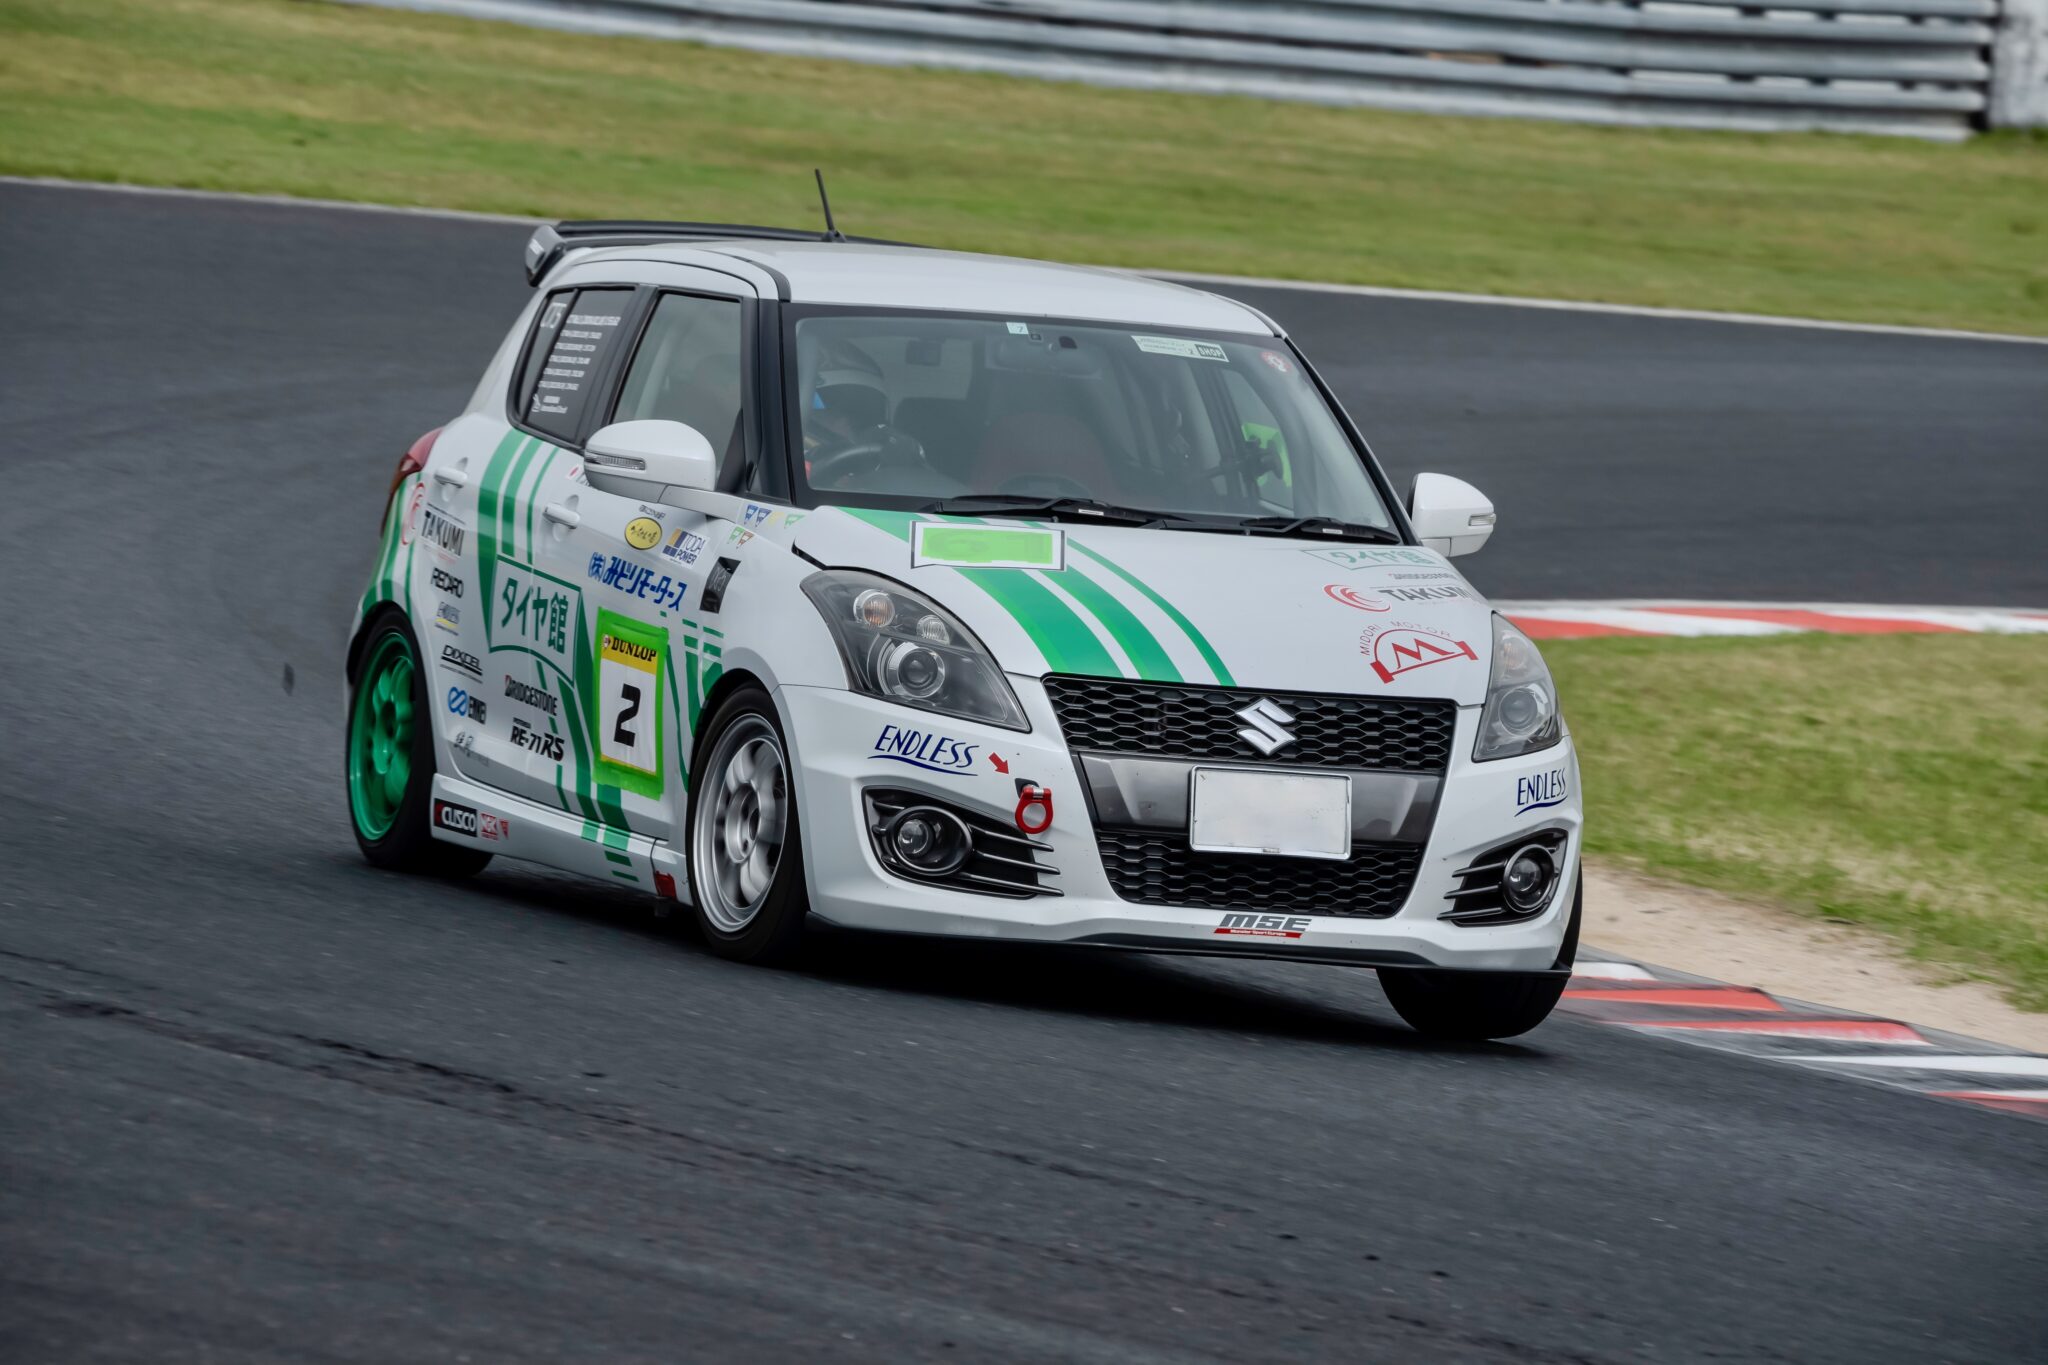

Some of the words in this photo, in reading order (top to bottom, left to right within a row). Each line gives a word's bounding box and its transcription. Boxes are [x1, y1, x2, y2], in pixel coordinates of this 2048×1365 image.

[675, 548, 698, 566] POWER
[501, 577, 569, 655] タイヤ館
[611, 636, 657, 663] DUNLOP
[1359, 623, 1383, 656] MIDORI
[1390, 620, 1451, 638] MOTOR
[613, 683, 641, 748] 2
[874, 724, 981, 768] ENDLESS
[1517, 767, 1567, 806] ENDLESS
[441, 805, 477, 832] CUSCO
[1218, 913, 1313, 932] MSE
